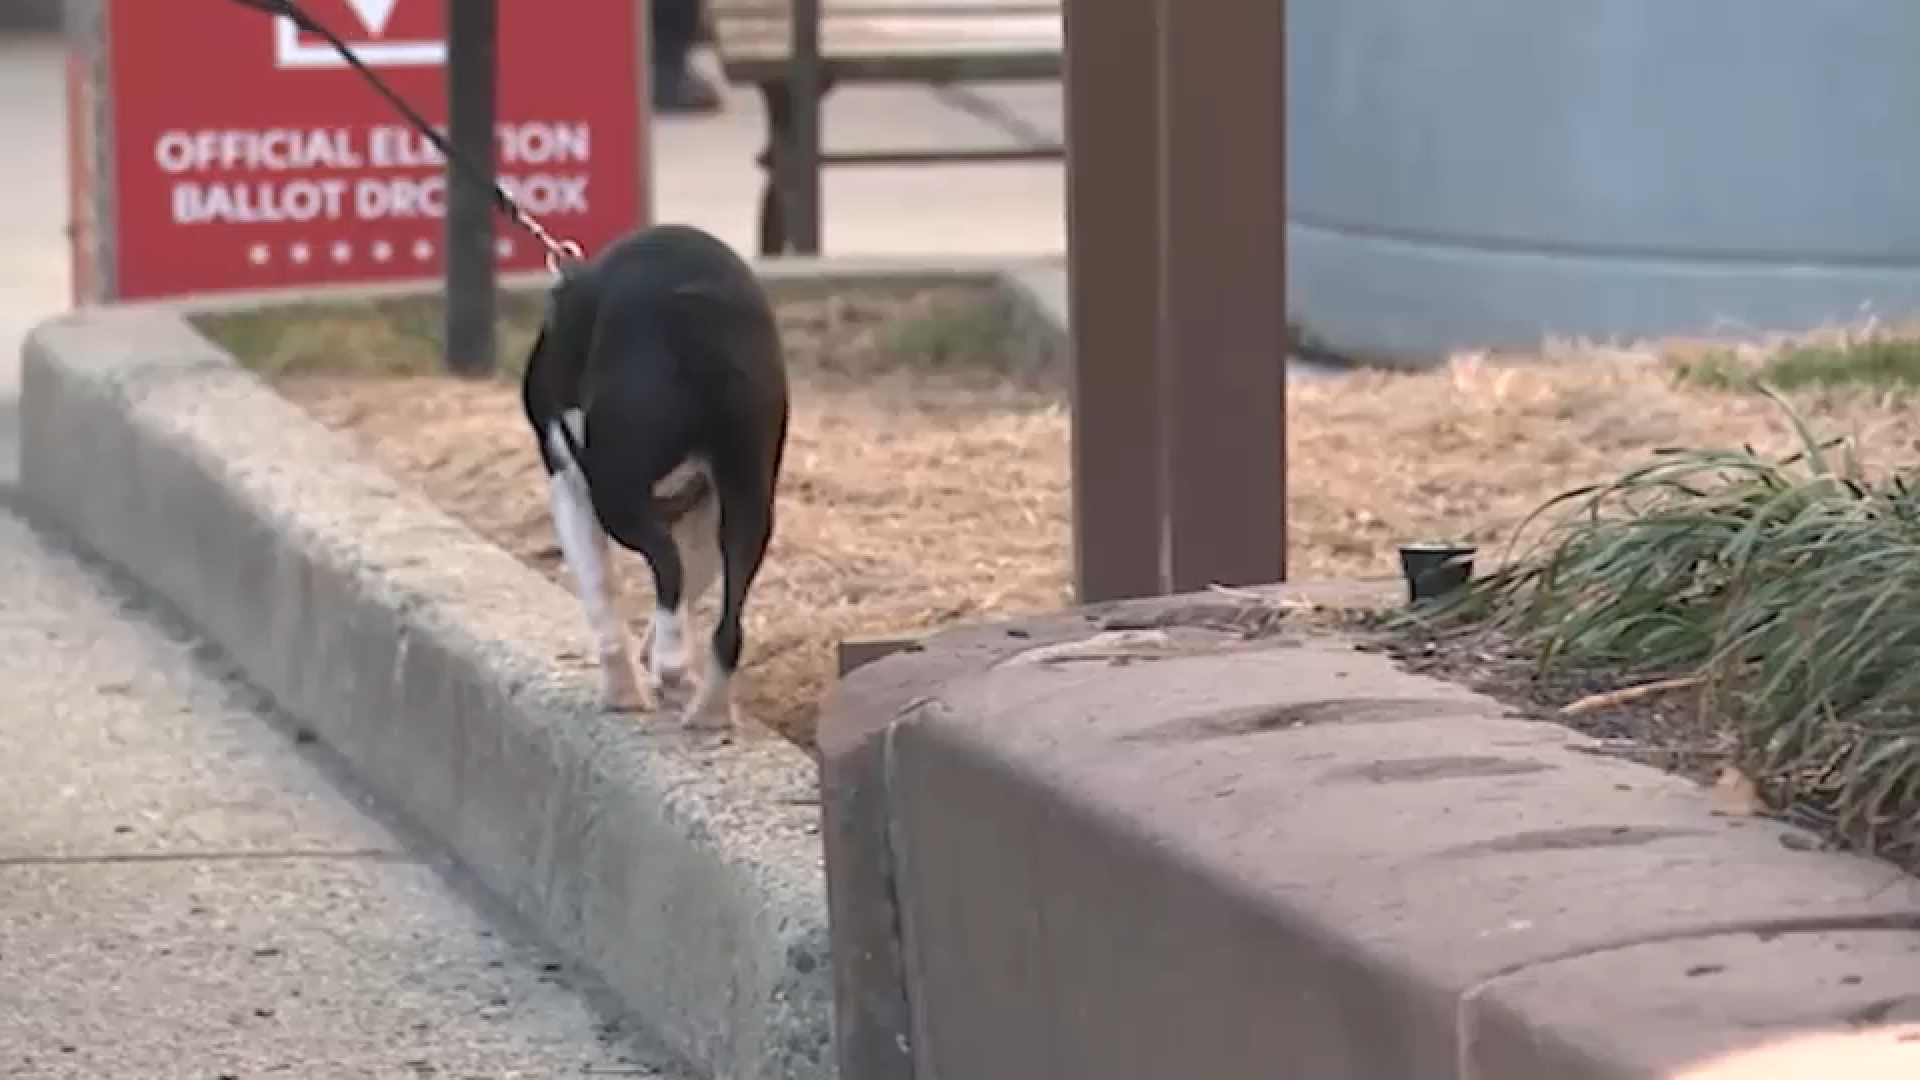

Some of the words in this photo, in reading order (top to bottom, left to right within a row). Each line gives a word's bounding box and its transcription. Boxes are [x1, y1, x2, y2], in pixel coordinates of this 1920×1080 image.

[154, 126, 363, 173] OFFICIAL
[368, 121, 590, 167] ELEION
[171, 177, 347, 223] BALLOT
[355, 175, 449, 219] DRO
